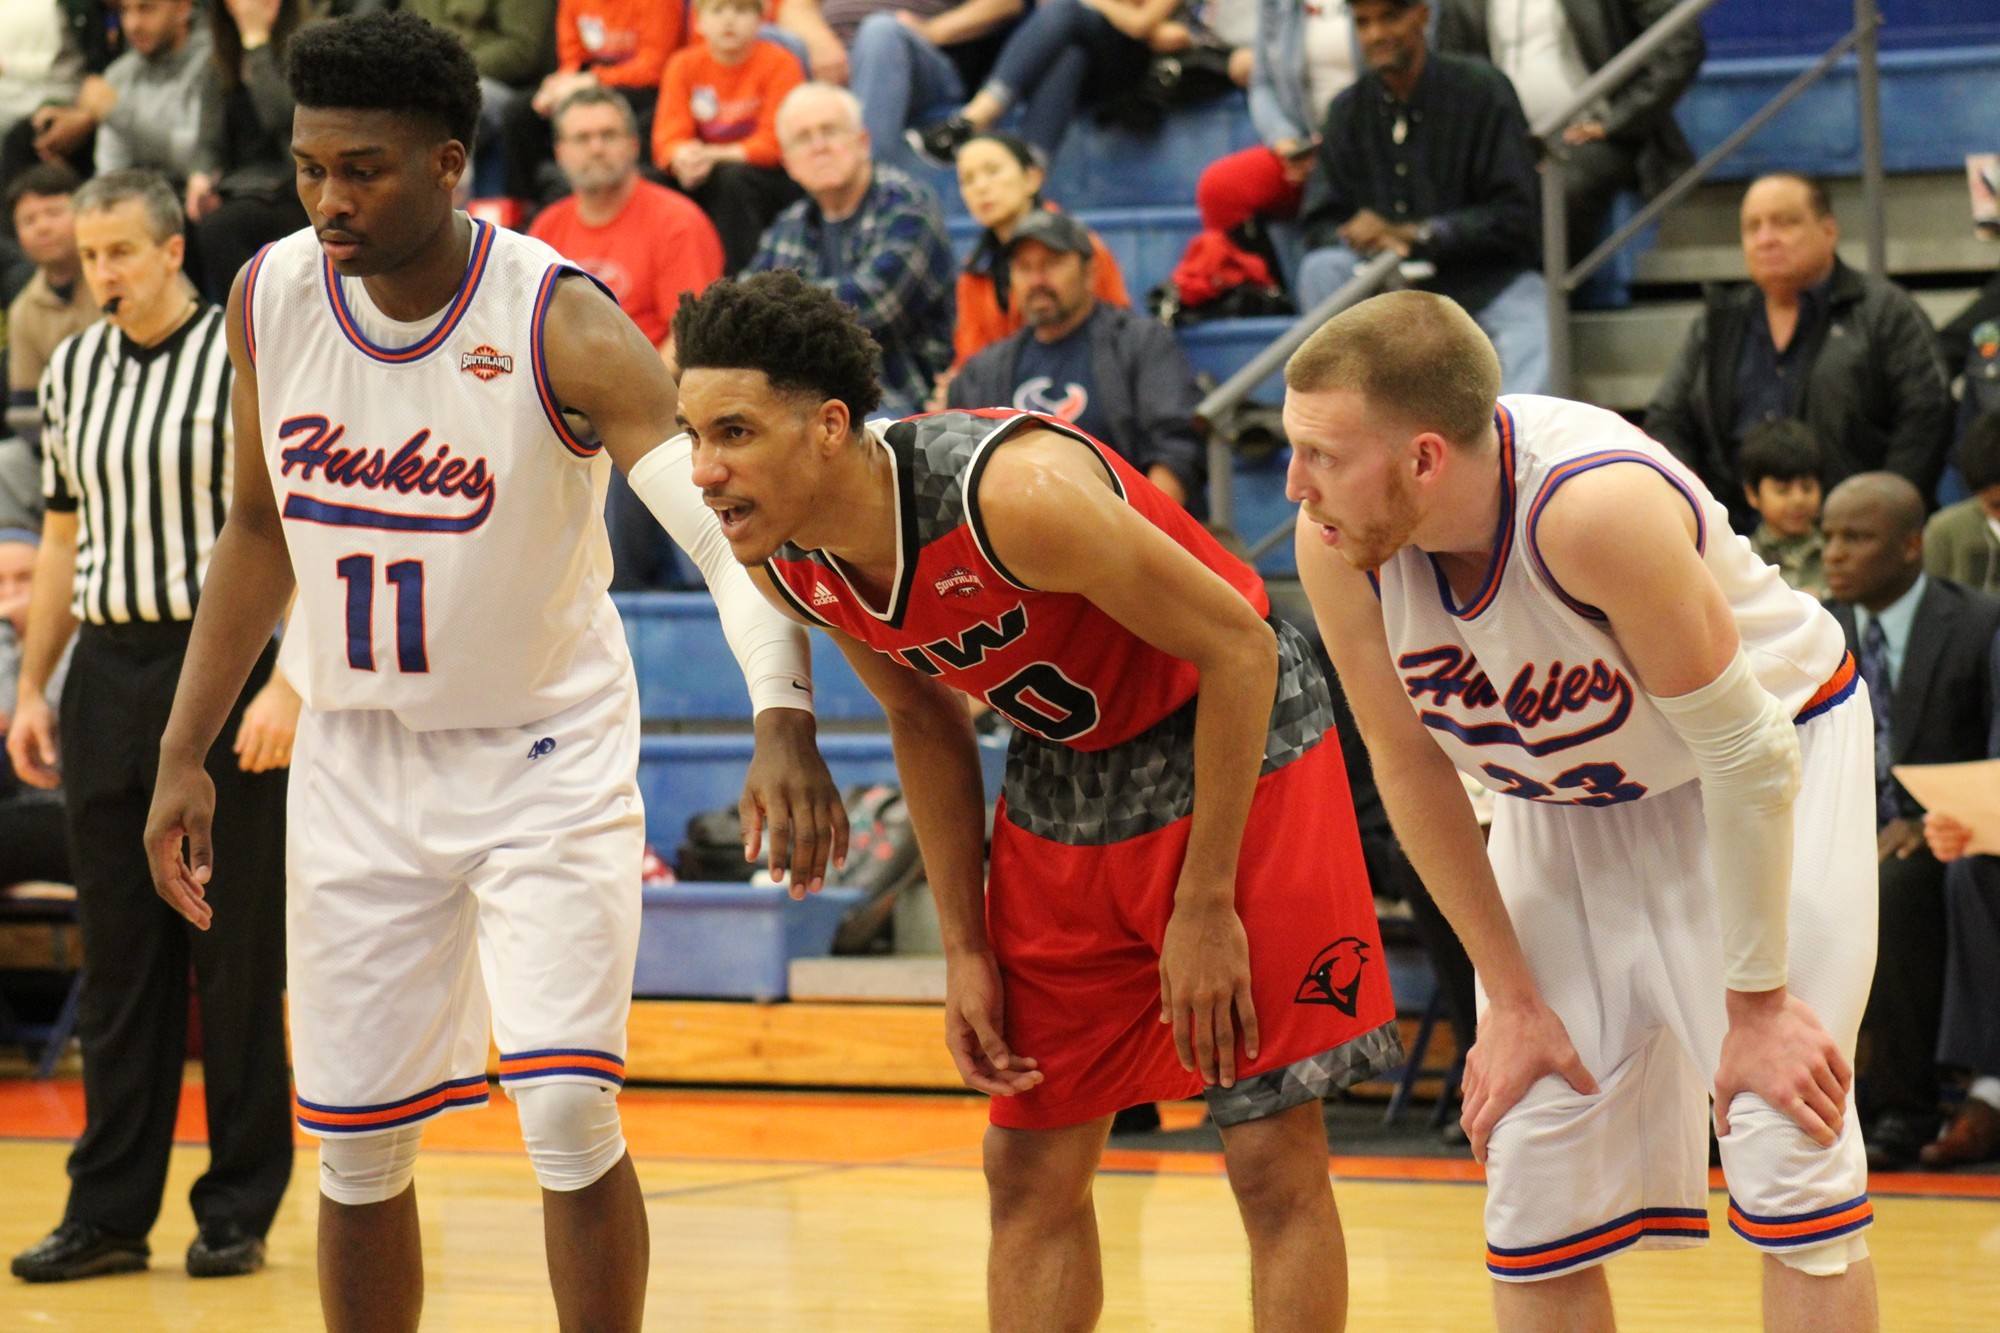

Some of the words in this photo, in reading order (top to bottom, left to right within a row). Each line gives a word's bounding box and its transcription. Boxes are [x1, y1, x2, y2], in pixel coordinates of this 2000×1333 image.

[462, 353, 512, 372] SOUTHLAND
[279, 414, 496, 500] Huskies
[336, 552, 430, 674] 11
[984, 661, 1100, 742] 0
[1397, 645, 1634, 728] Hukies
